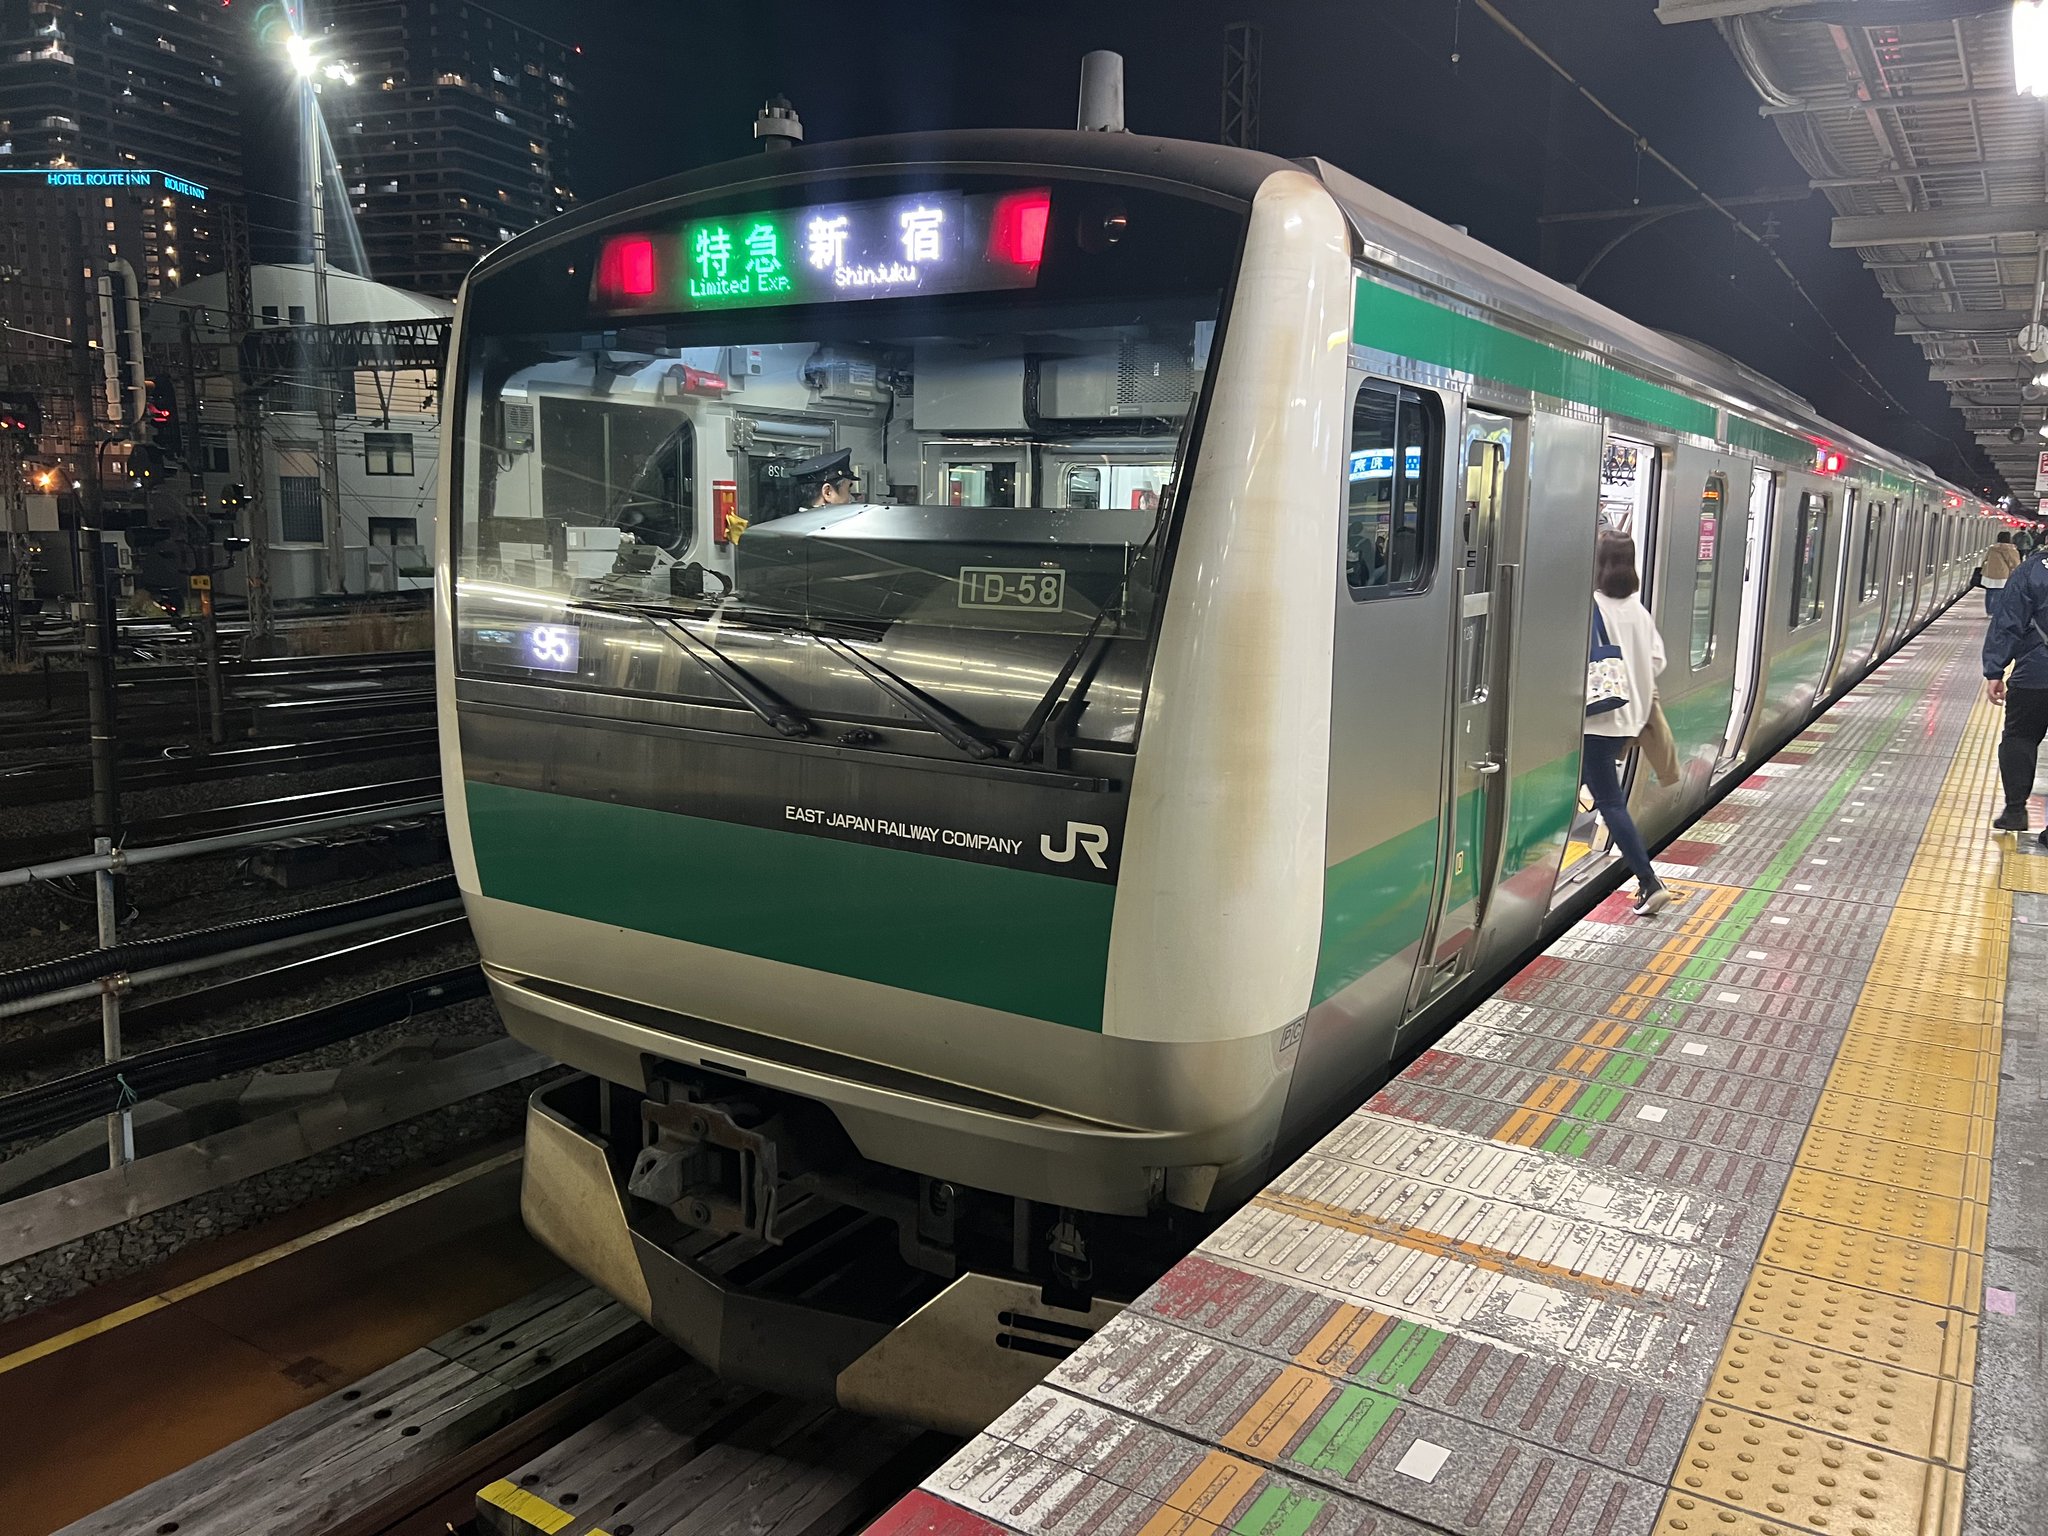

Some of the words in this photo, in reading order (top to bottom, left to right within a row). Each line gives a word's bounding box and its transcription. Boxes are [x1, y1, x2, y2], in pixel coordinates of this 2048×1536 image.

[47, 173, 84, 186] HOTEL
[86, 173, 124, 186] ROUTE
[126, 173, 151, 186] INN
[164, 176, 189, 196] ROUTE
[189, 185, 205, 200] INN
[695, 224, 782, 278] 特急
[808, 206, 943, 270] 新宿
[690, 275, 750, 297] Limited
[835, 261, 916, 287] Shinjuku
[532, 625, 569, 662] 95
[785, 805, 825, 824] EAST
[826, 813, 875, 833] JAPAN
[877, 819, 940, 842] RAILWAY
[942, 830, 1022, 855] COMPANY
[1040, 821, 1108, 870] JR
